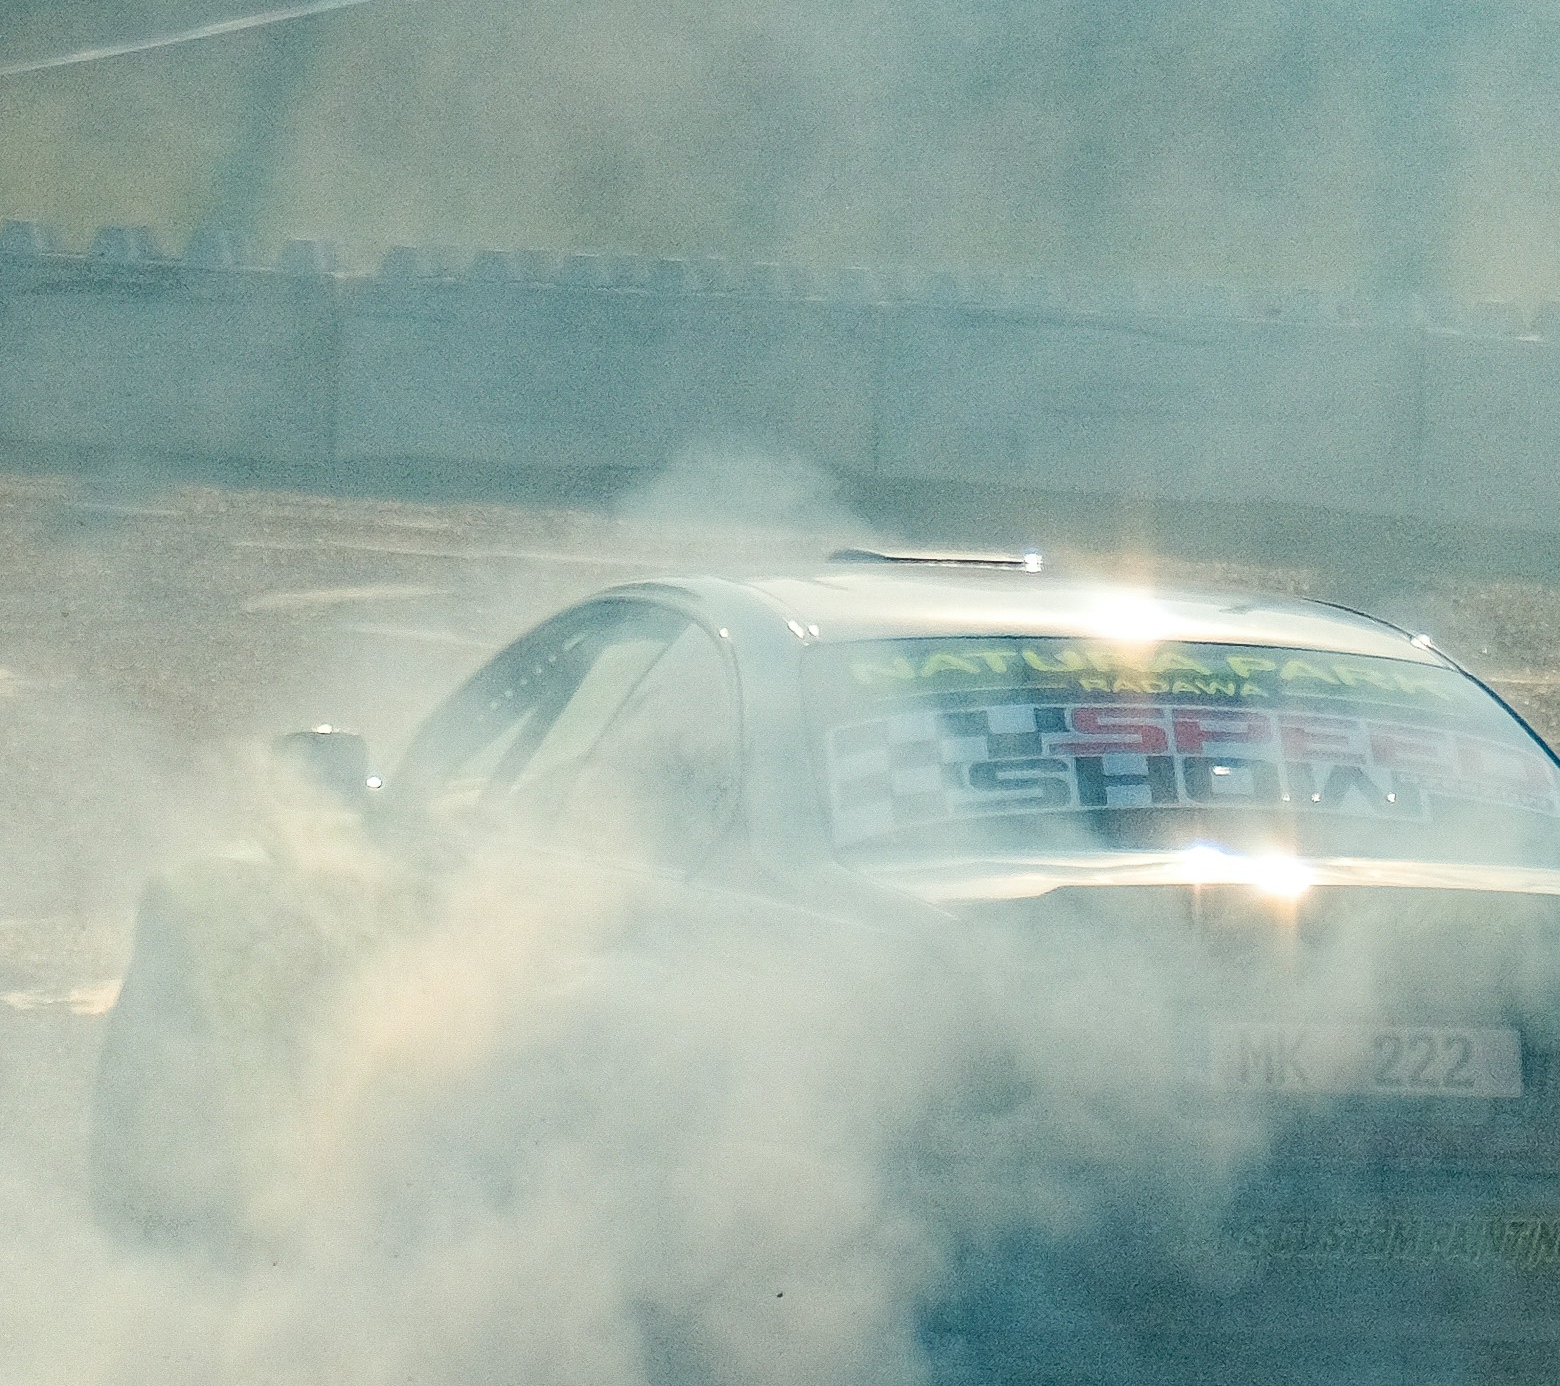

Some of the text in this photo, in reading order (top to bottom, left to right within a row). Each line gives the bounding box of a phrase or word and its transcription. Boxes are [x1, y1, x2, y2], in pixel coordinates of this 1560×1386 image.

[851, 646, 1450, 704] NATURA PARK
[1079, 675, 1270, 700] RADAWA
[1049, 706, 1556, 794] SPEED
[953, 756, 1423, 822] SHOW
[1372, 1032, 1475, 1090] 222
